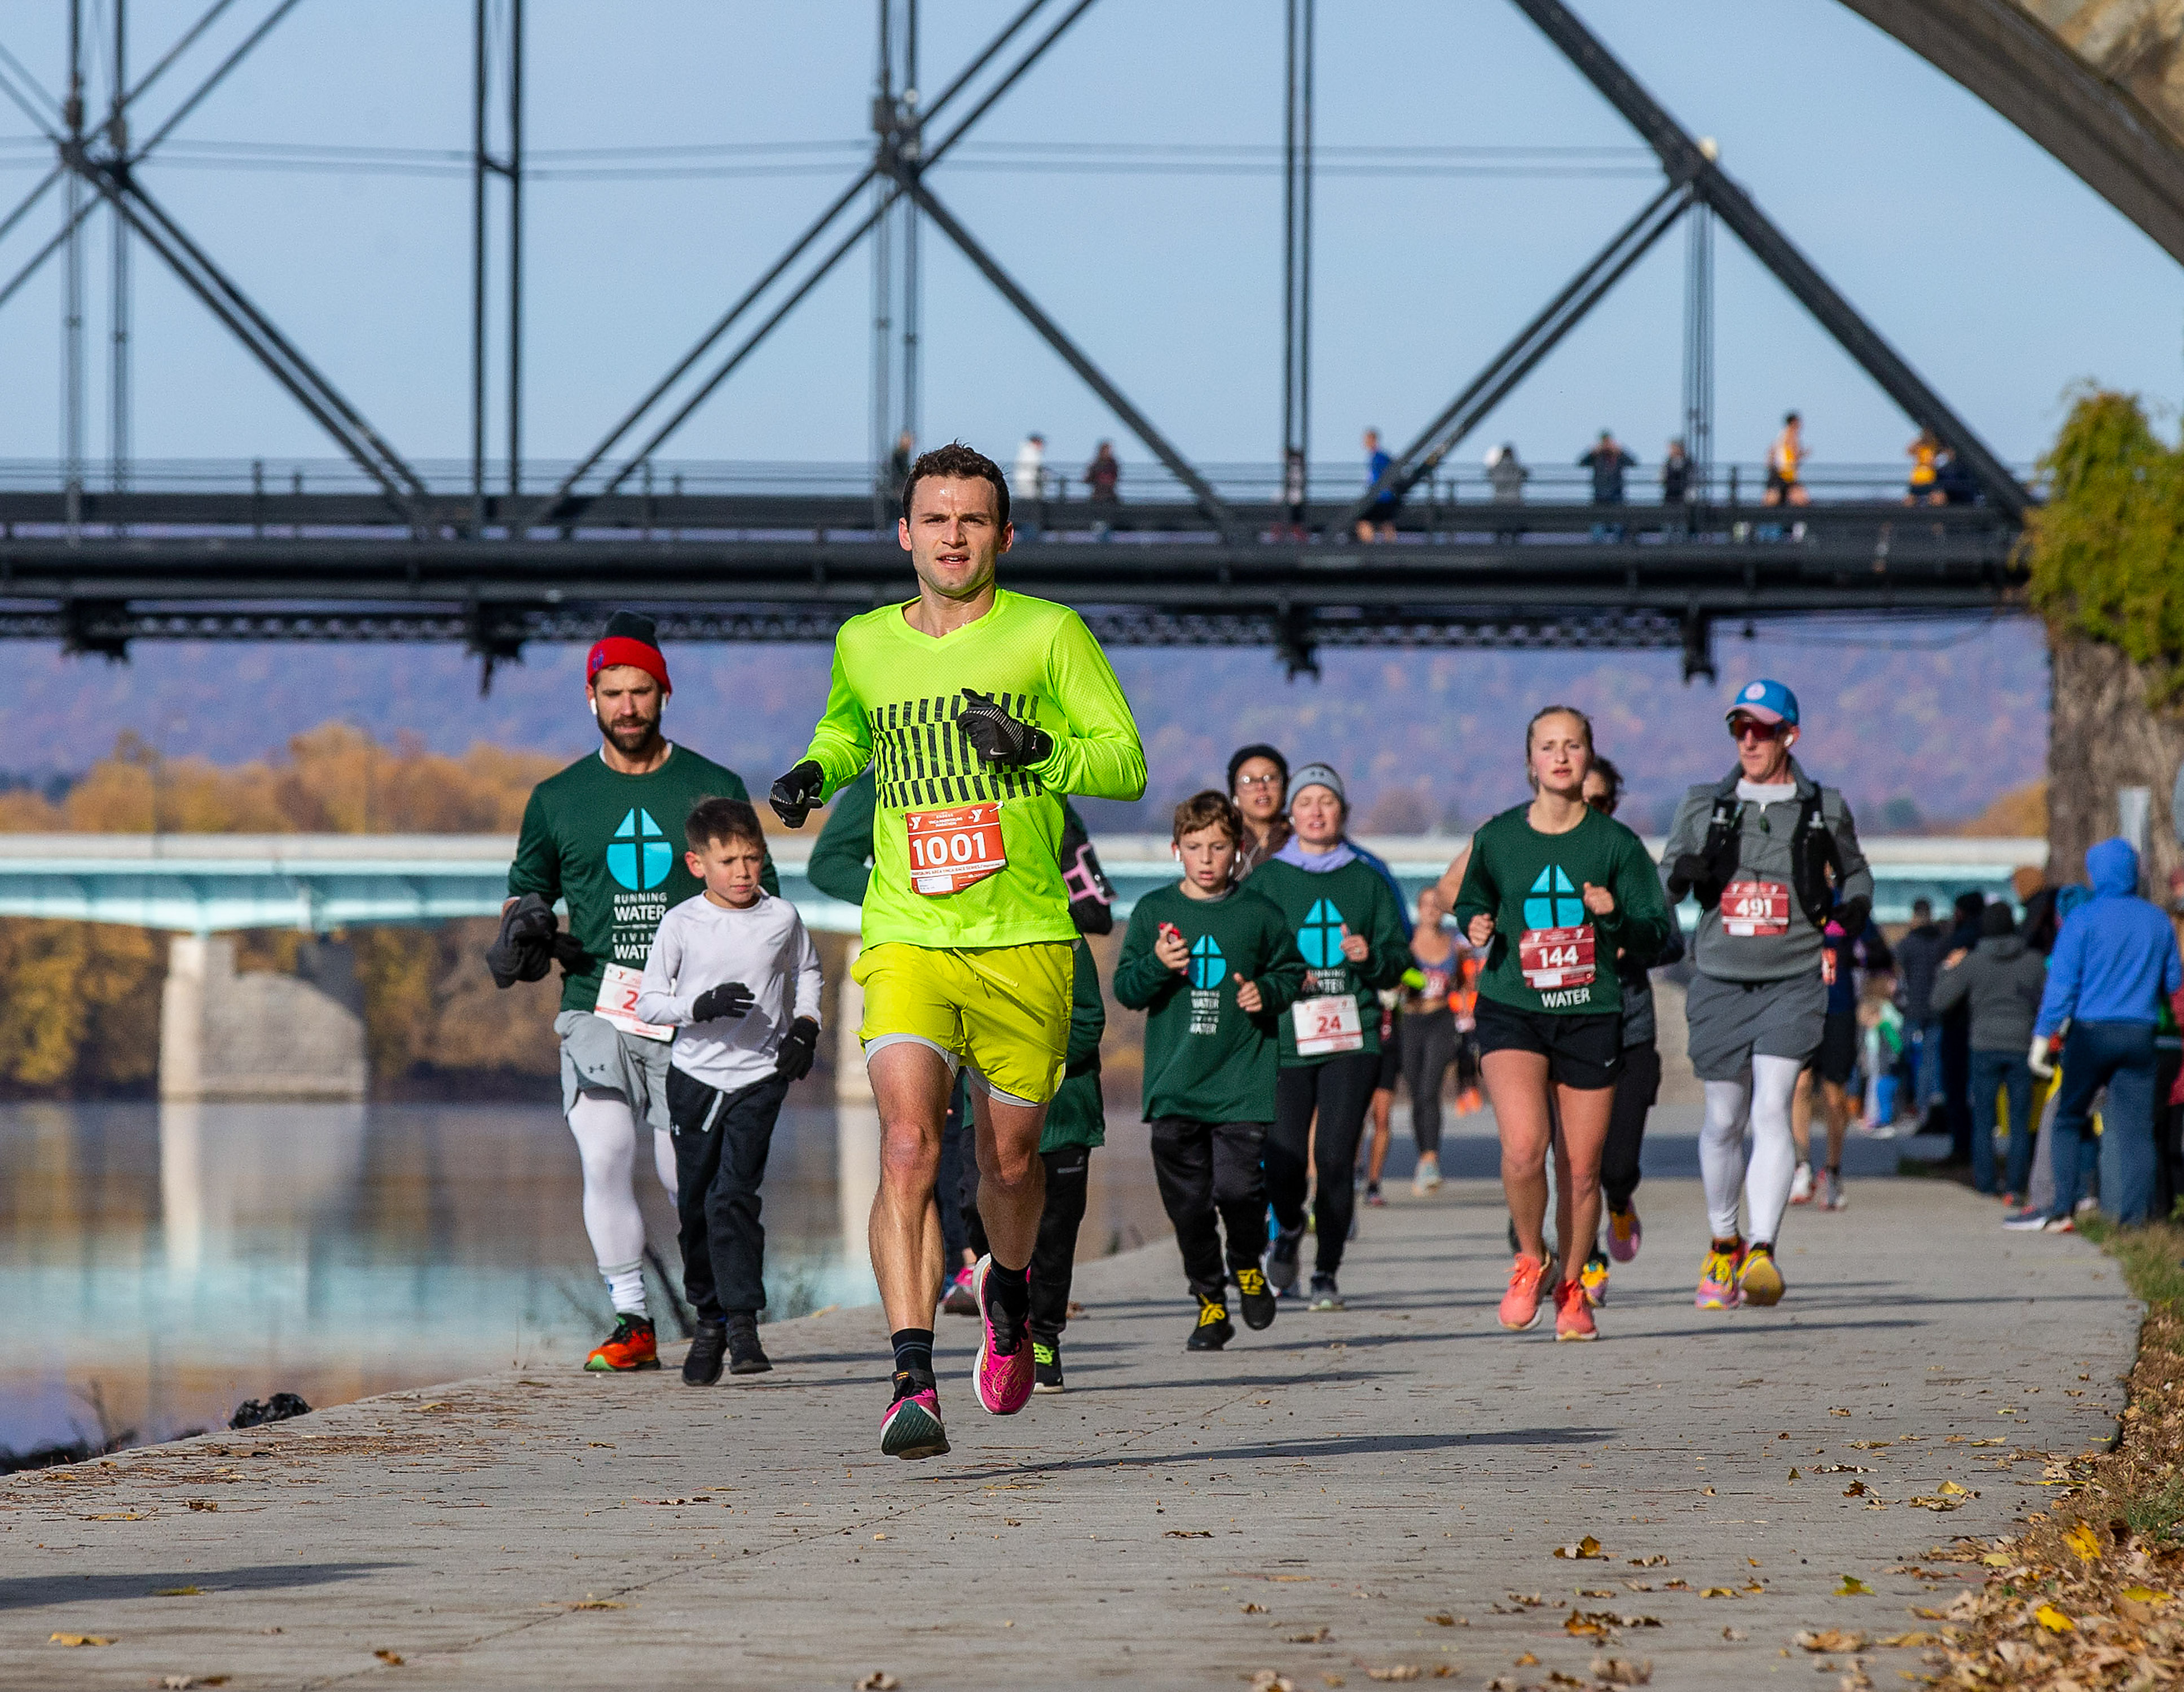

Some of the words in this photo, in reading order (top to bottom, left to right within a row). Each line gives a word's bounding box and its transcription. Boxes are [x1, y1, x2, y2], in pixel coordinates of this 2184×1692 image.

[913, 831, 986, 866] 1001
[614, 892, 667, 905] RUNNING
[1734, 897, 1772, 919] 491
[613, 905, 666, 922] WATER
[612, 932, 655, 944] LIVIN
[614, 944, 652, 960] WAT
[1539, 945, 1579, 968] 144
[623, 990, 639, 1011] 2
[1541, 987, 1591, 1008] WATER
[1317, 1015, 1341, 1033] 24
